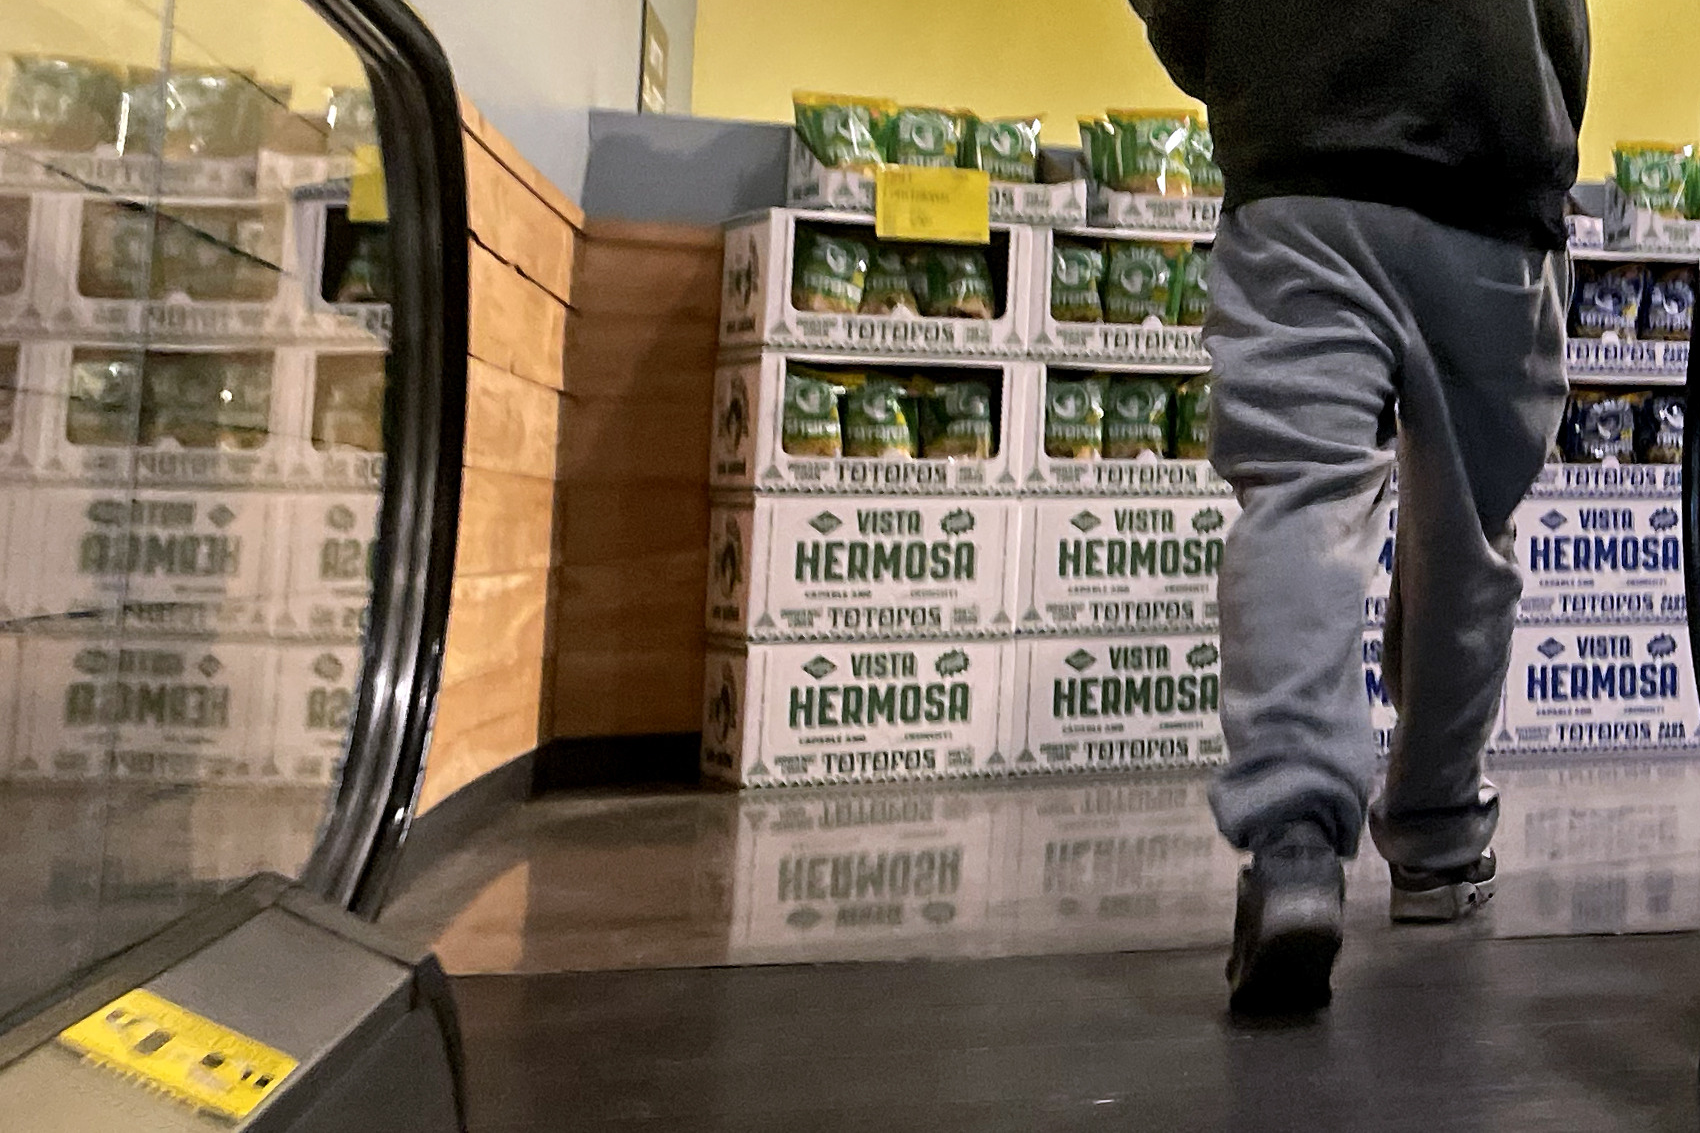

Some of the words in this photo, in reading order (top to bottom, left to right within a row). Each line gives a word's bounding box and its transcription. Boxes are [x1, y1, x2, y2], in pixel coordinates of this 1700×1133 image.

[834, 462, 947, 484] TOTOPOS
[1092, 464, 1198, 484] TOTOPOS
[1562, 467, 1657, 486] TOTOPOS
[857, 508, 922, 536] VISTA
[1114, 508, 1174, 533] VISTA
[1578, 508, 1633, 531] VISTA
[795, 540, 976, 582] HERMOSA
[1059, 537, 1225, 577] HERMOSA
[1530, 536, 1679, 572] HERMOSA
[1090, 601, 1194, 620] TOTOPOS
[1559, 594, 1653, 612] TOTOPOS
[828, 607, 941, 628] TOTOPOS
[1109, 645, 1169, 670] VISTA
[1576, 635, 1631, 659] VISTA
[851, 651, 916, 678] VISTA
[1527, 663, 1678, 700] HERMOSA
[789, 682, 970, 728] HERMOSA
[1053, 673, 1219, 717] HERMOSA
[1557, 721, 1651, 741] TOTOPOS
[823, 750, 935, 774] TOTOPOS
[1083, 739, 1188, 761] TOTOPOS
